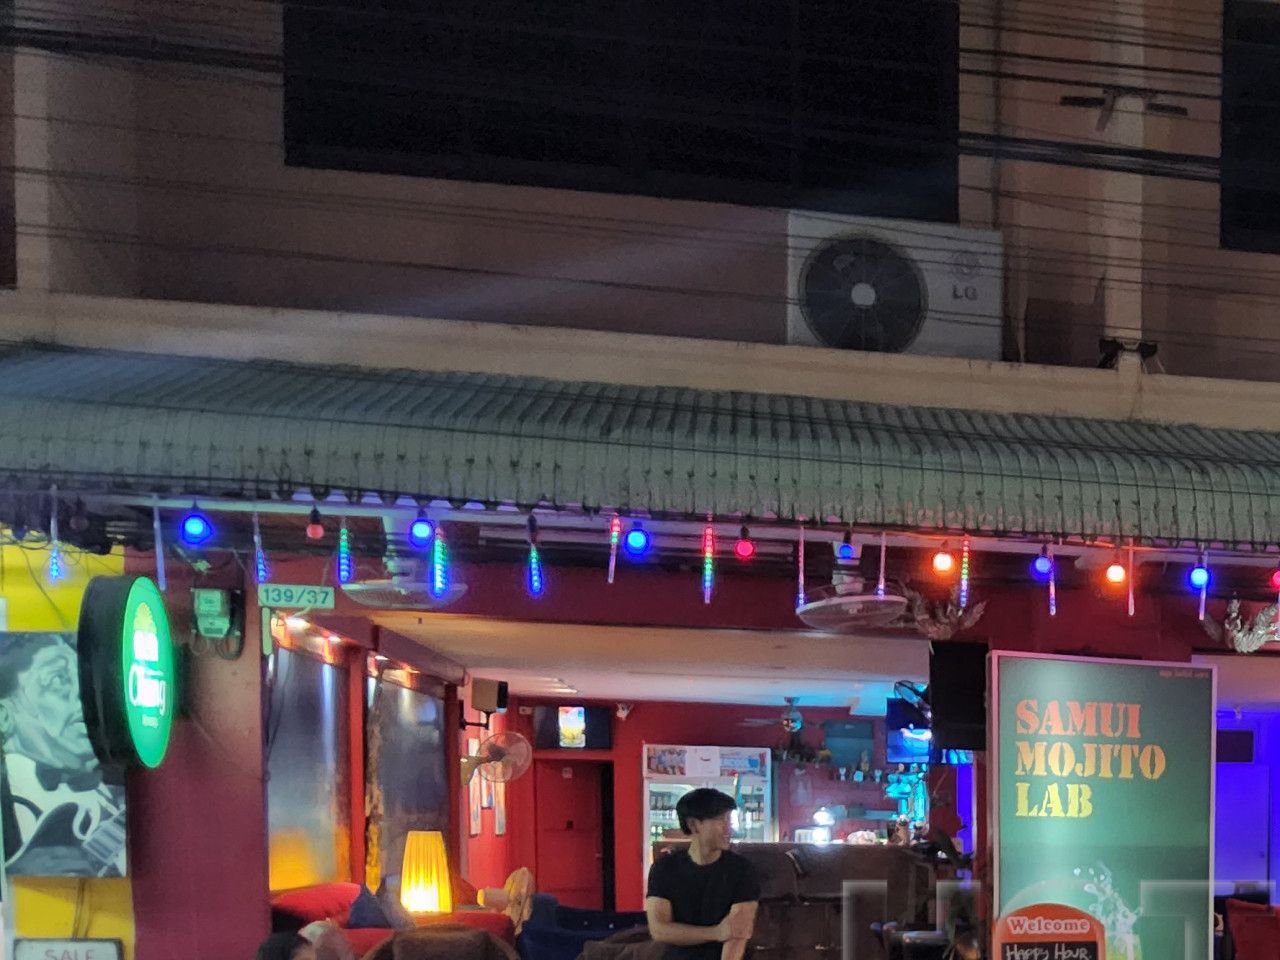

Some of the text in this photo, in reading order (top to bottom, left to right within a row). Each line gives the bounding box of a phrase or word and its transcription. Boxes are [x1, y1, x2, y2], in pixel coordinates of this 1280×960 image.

[952, 285, 978, 300] LG
[263, 588, 329, 604] 139/37
[1015, 699, 1141, 738] SAMUI
[1015, 741, 1166, 779] MOJITO
[1015, 783, 1093, 817] LAB
[1007, 916, 1090, 934] Welcome
